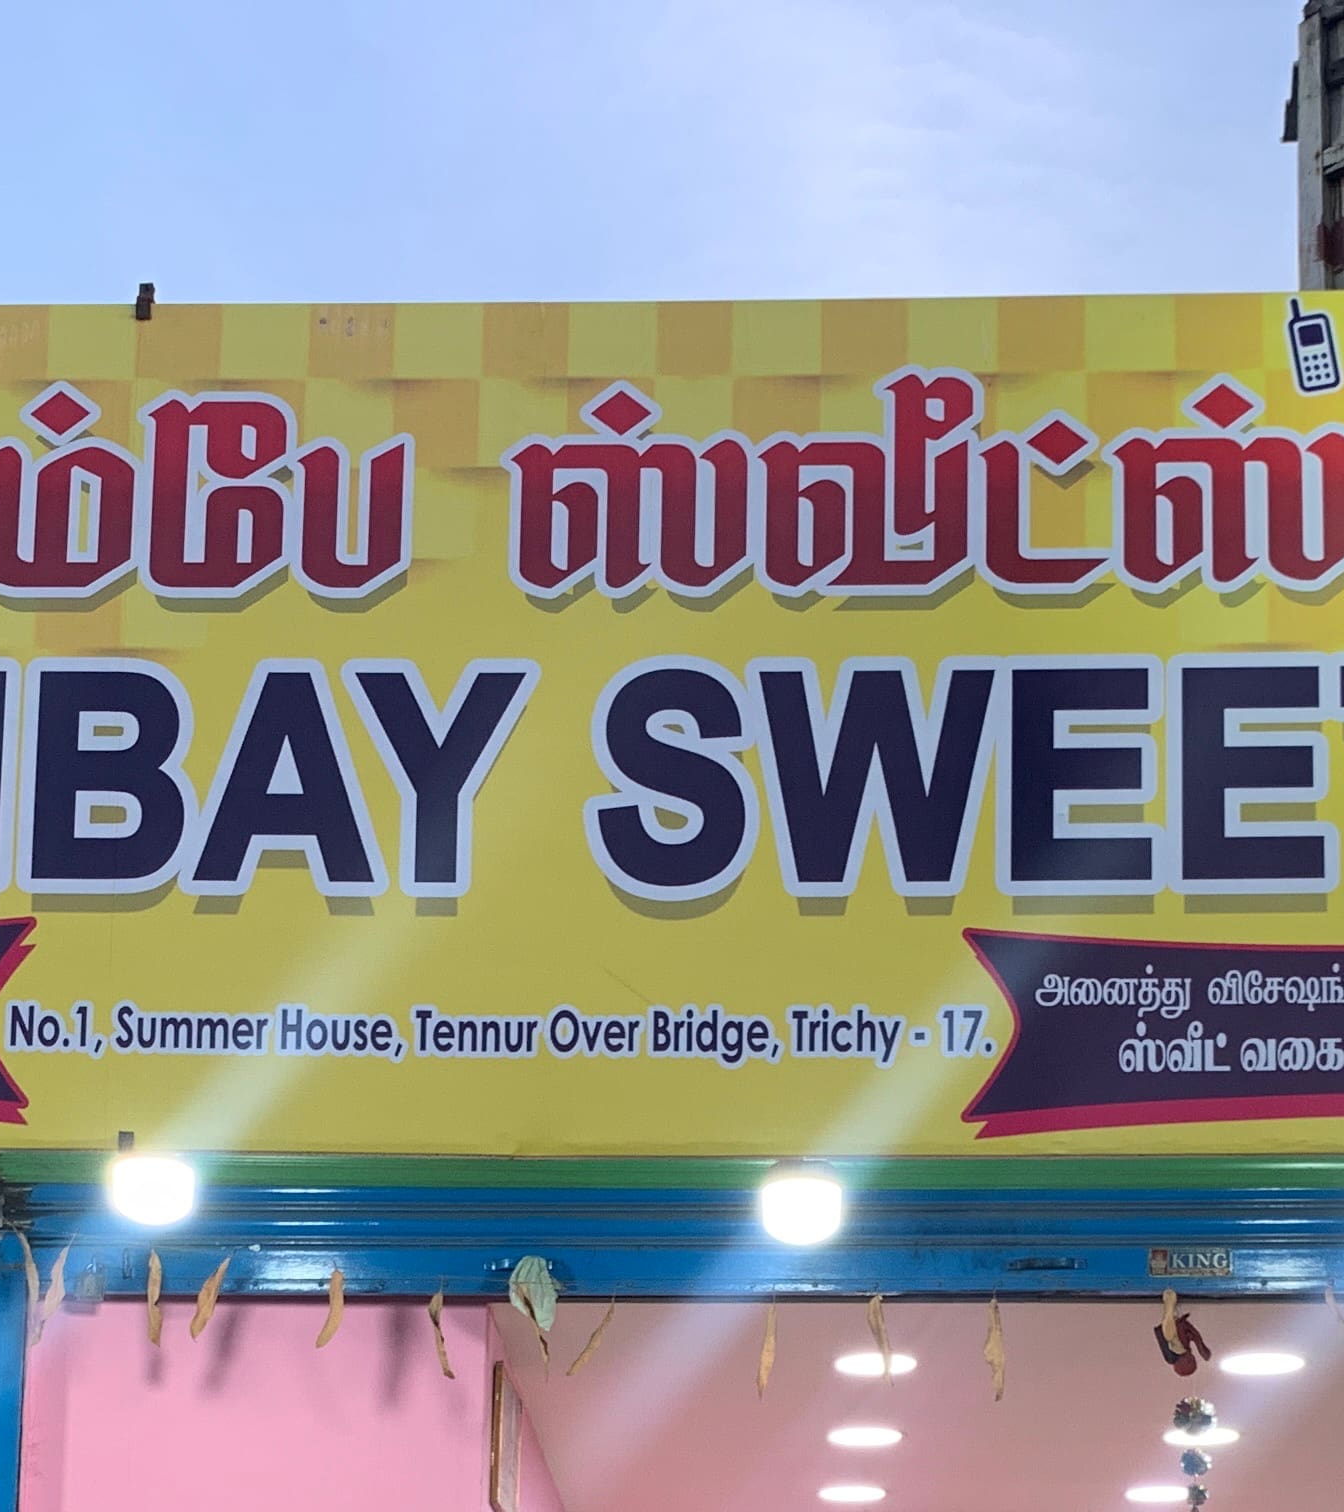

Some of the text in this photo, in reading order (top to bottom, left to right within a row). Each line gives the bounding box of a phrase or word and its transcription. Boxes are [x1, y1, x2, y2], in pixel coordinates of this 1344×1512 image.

[1034, 964, 1191, 1019] அனைத்து
[9, 1005, 105, 1056] No.1,
[116, 1006, 267, 1051] Summer
[281, 1007, 405, 1056] House,
[414, 1006, 539, 1053] Tennur
[549, 1006, 638, 1053] Over
[653, 1006, 779, 1063] Bridge,
[791, 1008, 899, 1062] Trichy
[940, 1009, 995, 1053] 17.
[1118, 1021, 1231, 1074] ஸ்வீட்
[1171, 1253, 1228, 1269] KING
